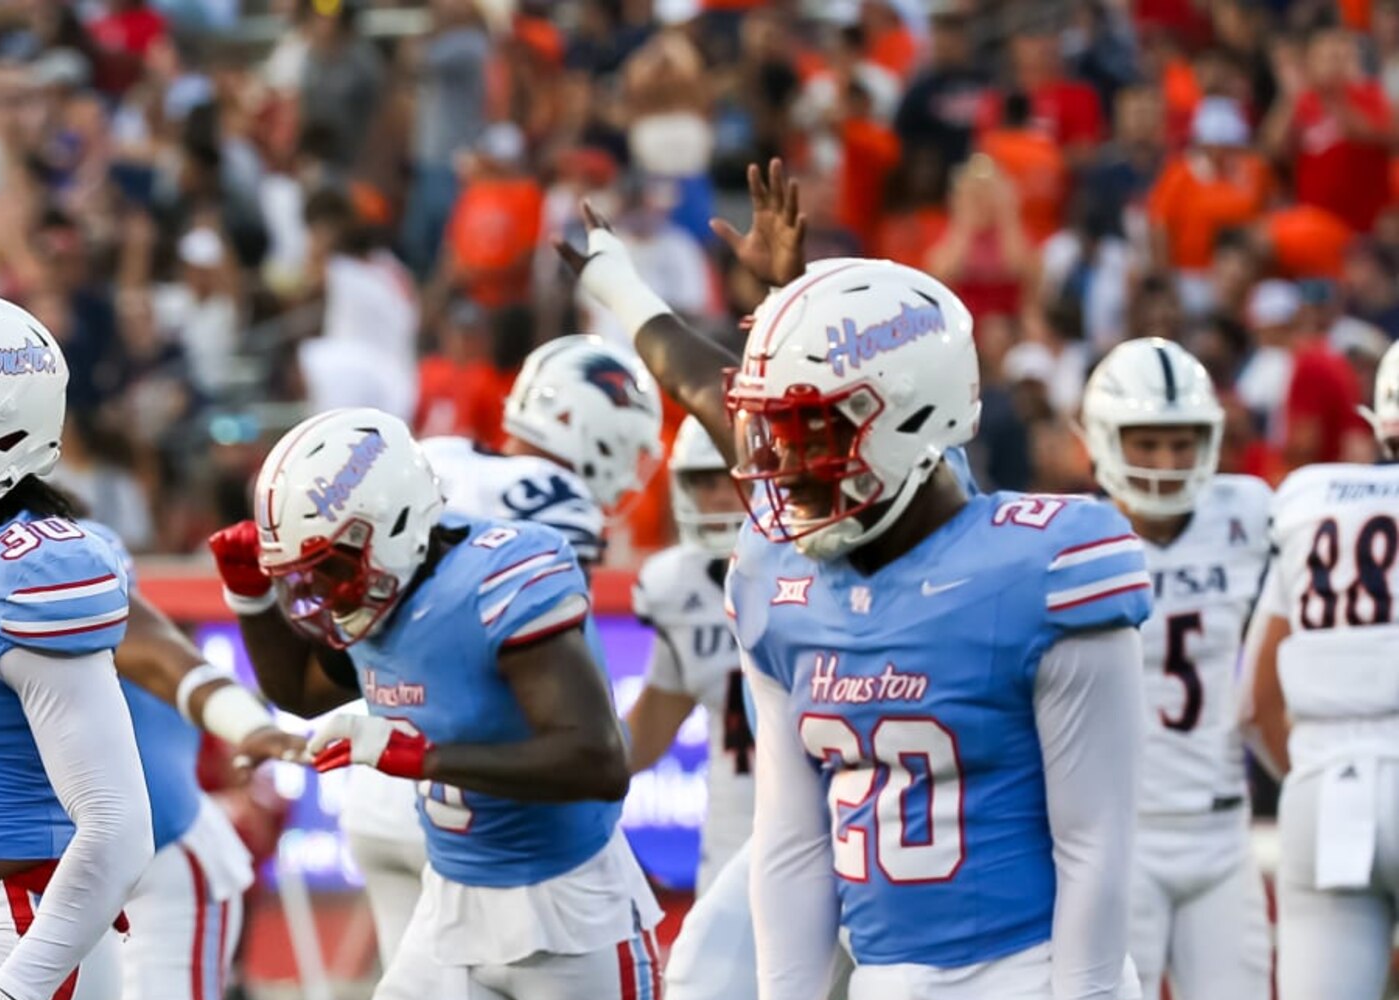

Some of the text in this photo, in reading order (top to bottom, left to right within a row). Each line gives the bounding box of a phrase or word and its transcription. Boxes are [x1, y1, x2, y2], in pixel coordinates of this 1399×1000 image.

[827, 302, 946, 377] Houston
[991, 493, 1078, 531] 2
[1301, 514, 1399, 630] 88
[363, 668, 426, 708] Houston
[811, 652, 931, 704] Houston
[1158, 612, 1204, 732] 5
[798, 712, 966, 886] 20
